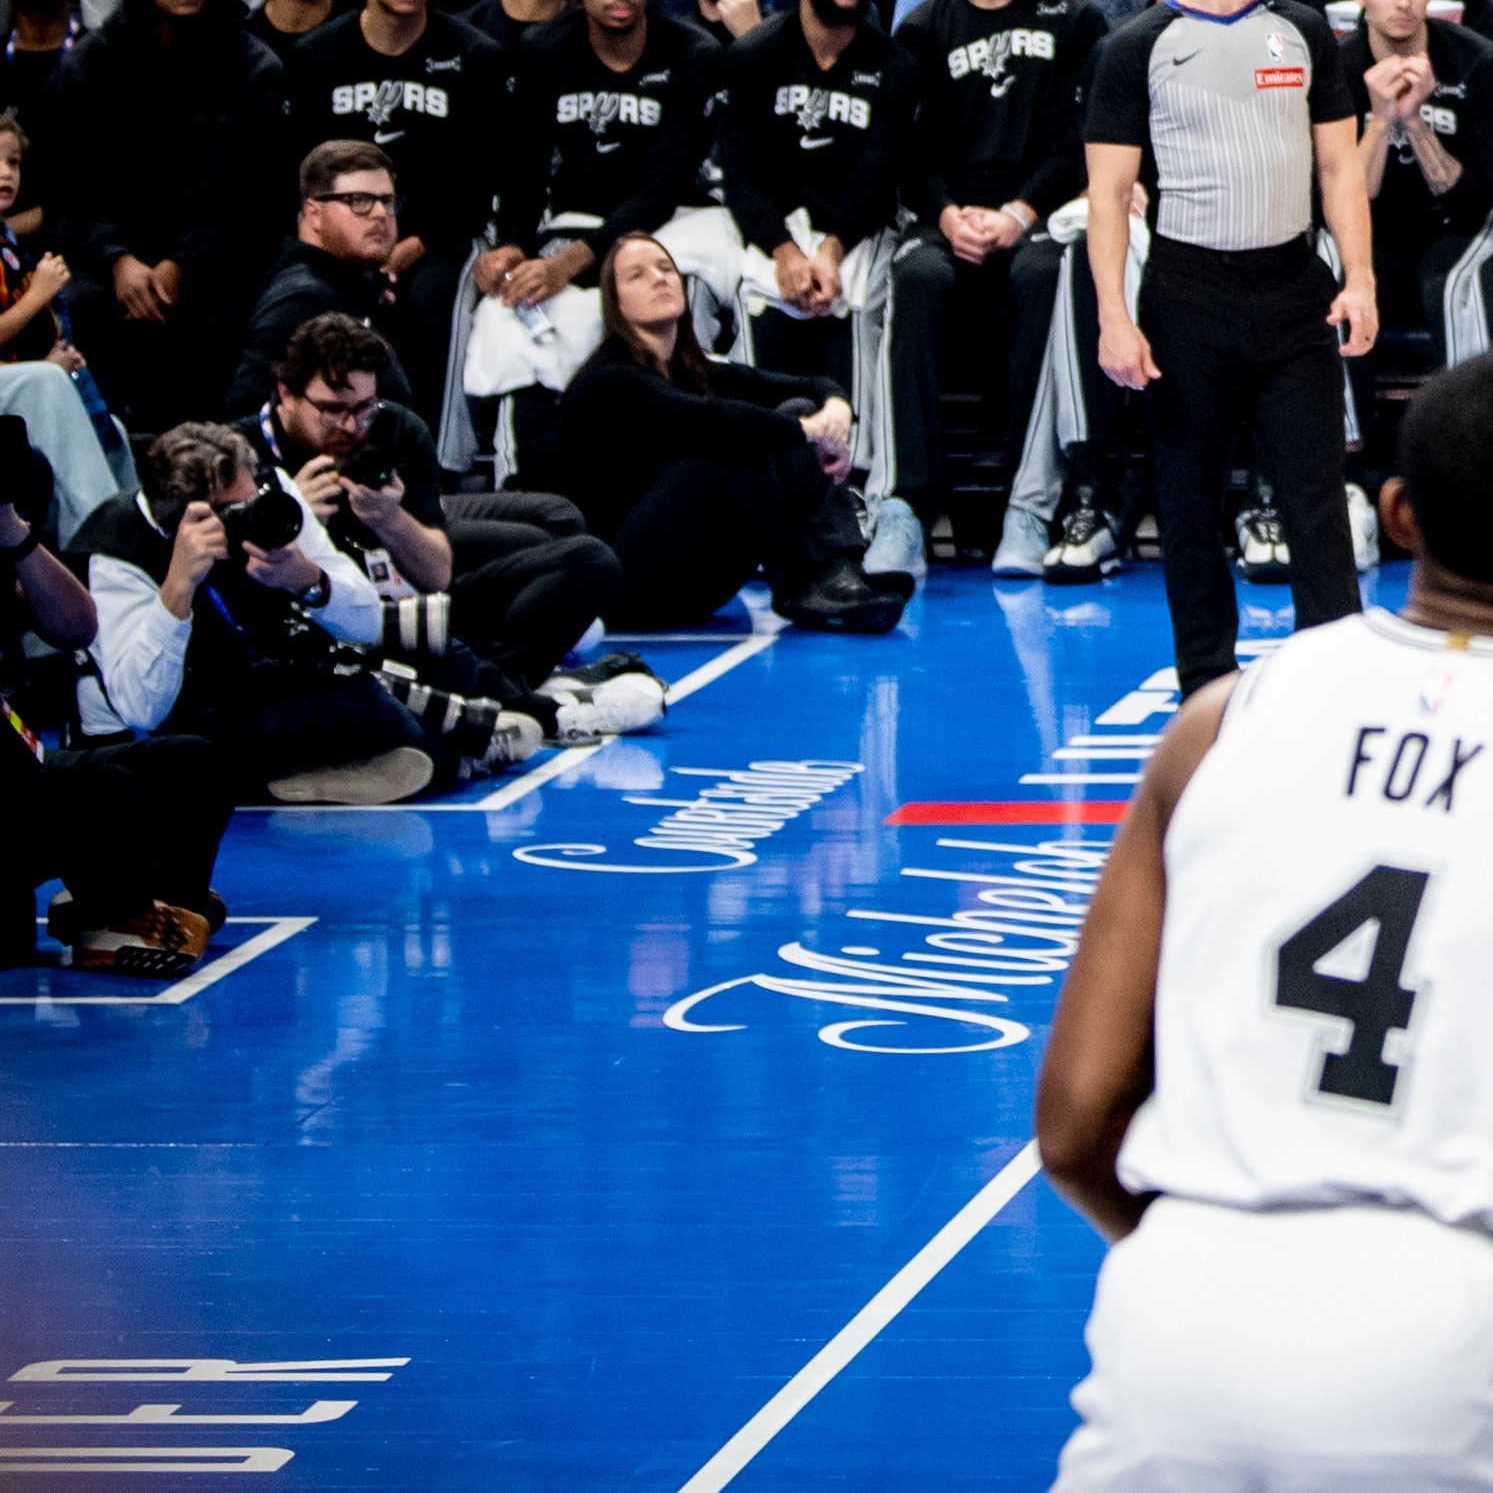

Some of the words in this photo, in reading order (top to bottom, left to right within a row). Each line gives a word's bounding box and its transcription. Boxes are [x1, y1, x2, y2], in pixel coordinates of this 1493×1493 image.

[948, 28, 1056, 82] SPURS
[332, 80, 449, 122] SPURS
[1256, 71, 1303, 86] Emirates
[556, 91, 662, 129] SPURS
[774, 84, 871, 129] SPURS
[1344, 726, 1484, 813] FOX
[1268, 861, 1430, 1110] 4
